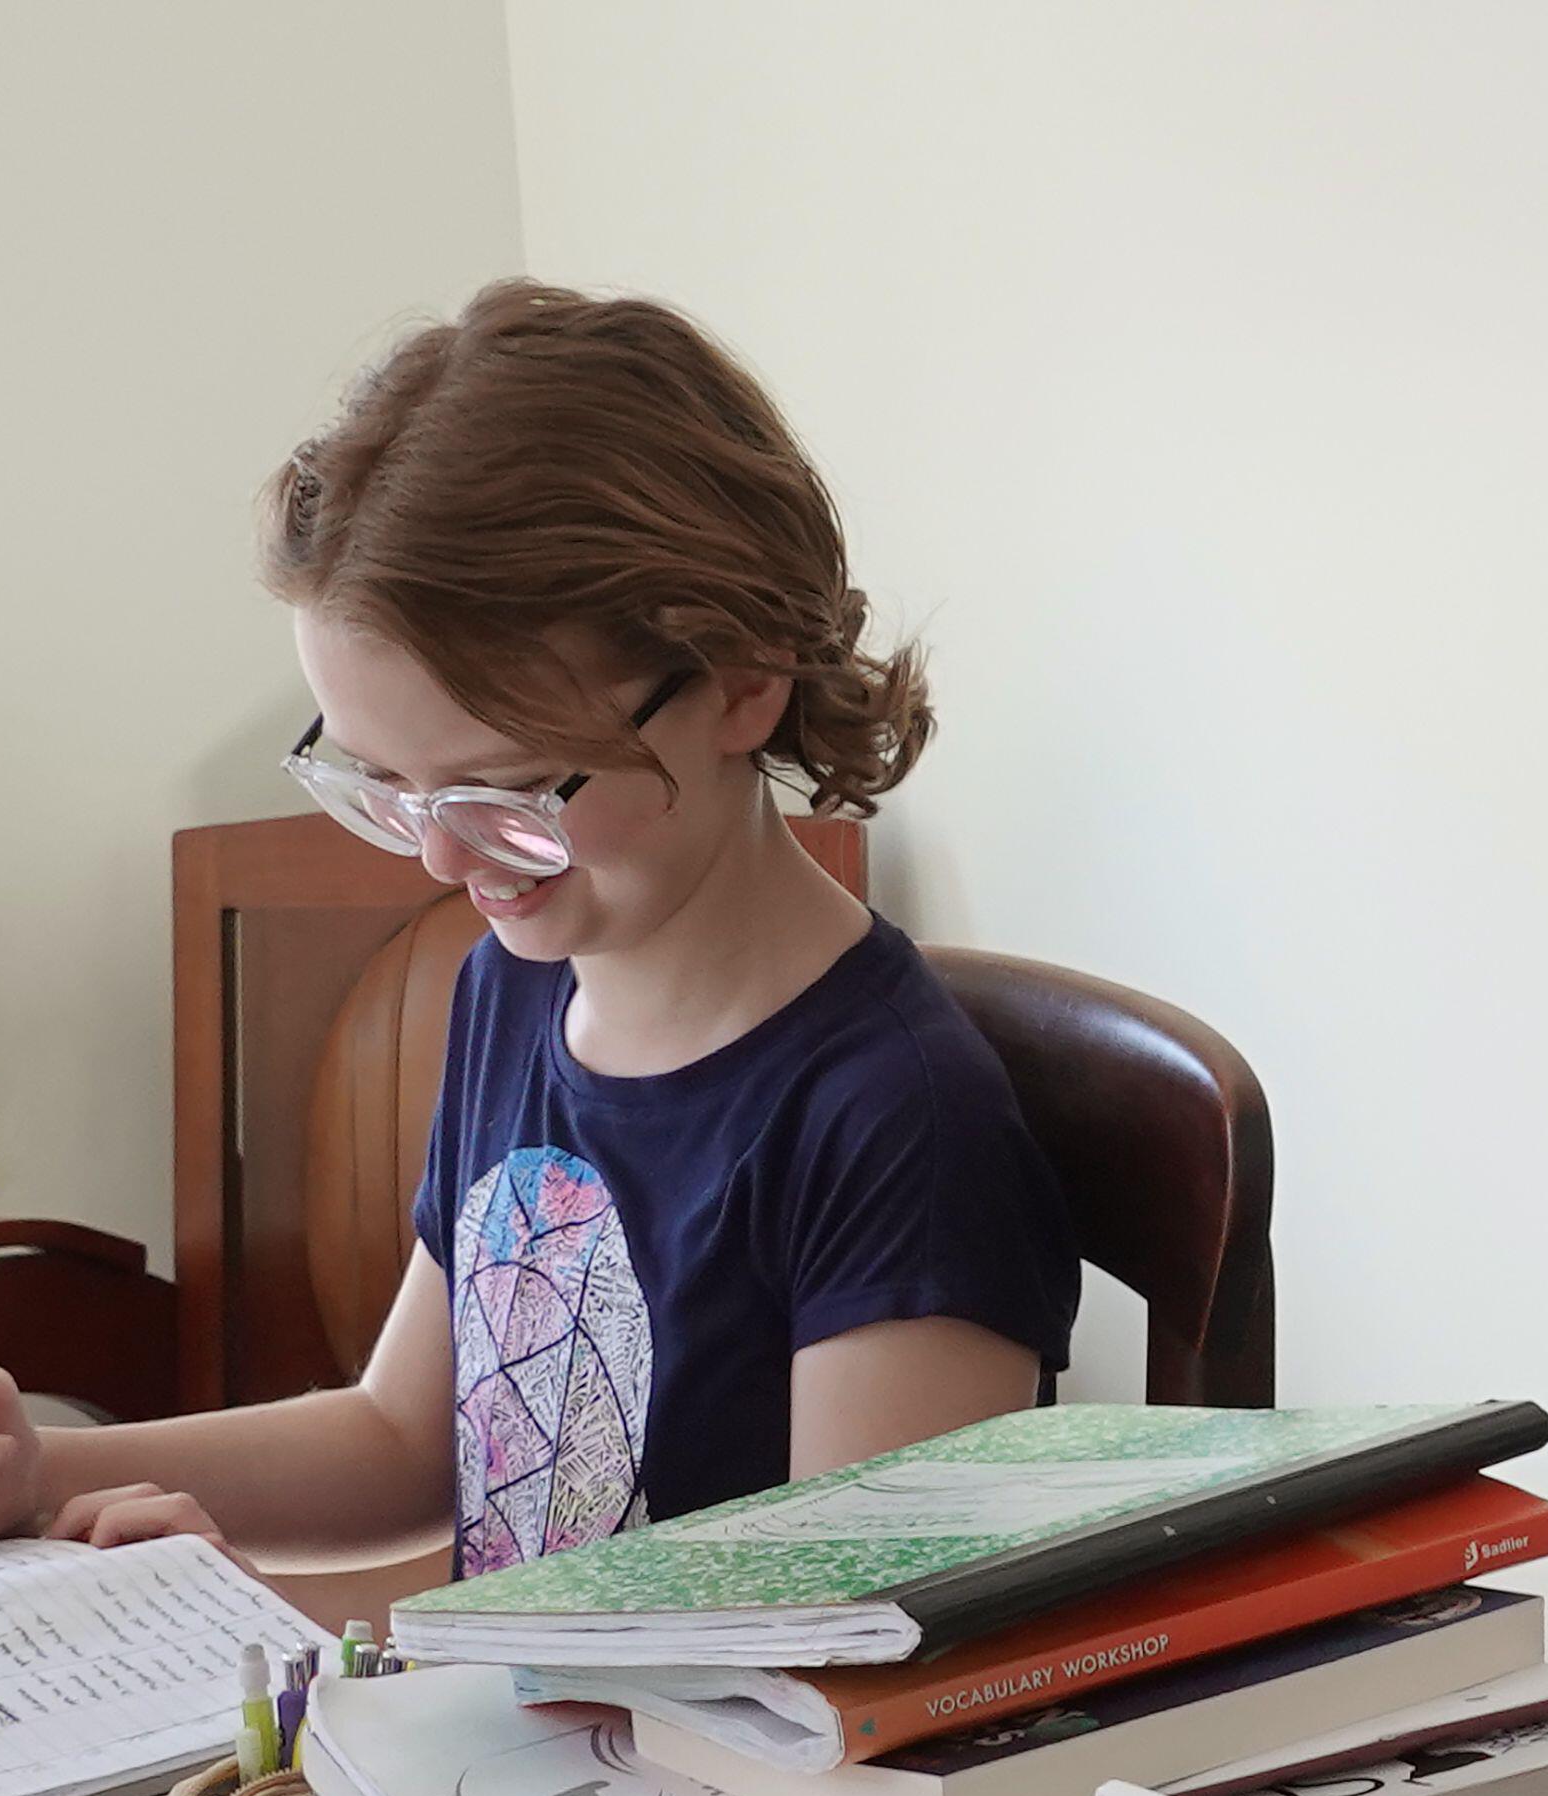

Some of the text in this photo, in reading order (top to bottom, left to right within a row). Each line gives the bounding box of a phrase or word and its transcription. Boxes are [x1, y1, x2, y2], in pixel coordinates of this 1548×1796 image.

[1480, 1533, 1530, 1561] Sadlier
[926, 1633, 1171, 1718] VOCABULARY WORKSHOP
